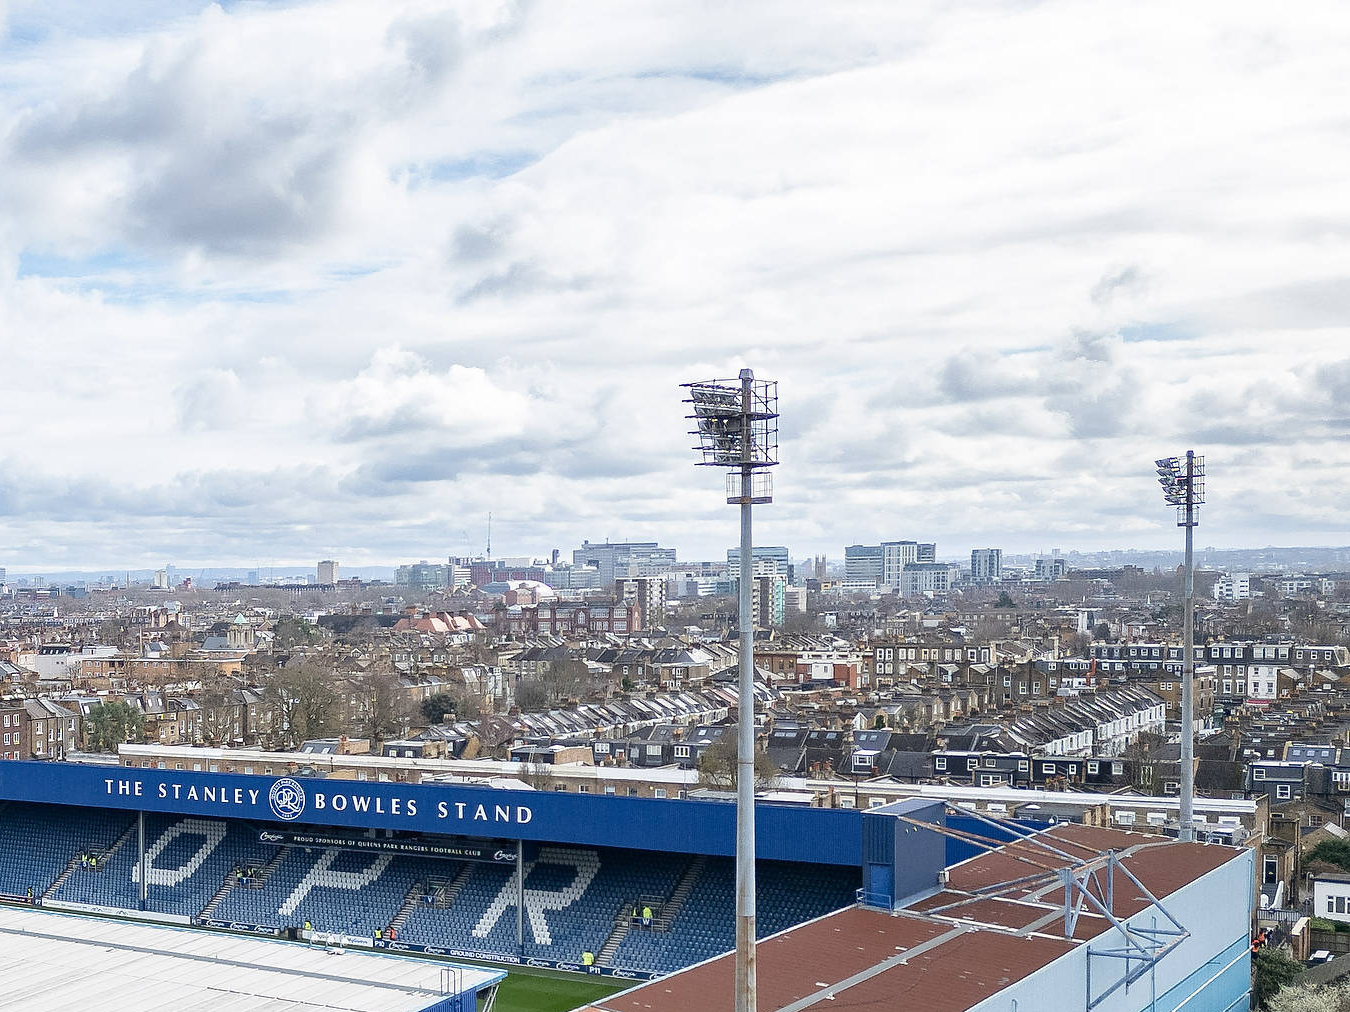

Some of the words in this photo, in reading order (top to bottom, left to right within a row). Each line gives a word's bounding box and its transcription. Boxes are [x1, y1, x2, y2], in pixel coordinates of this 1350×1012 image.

[105, 779, 143, 796] THE
[158, 782, 260, 805] STANLEY
[315, 793, 417, 816] BOWLES
[437, 801, 533, 824] STAND
[450, 949, 475, 959] GROUND
[475, 952, 520, 964] CONSTRUCTION
